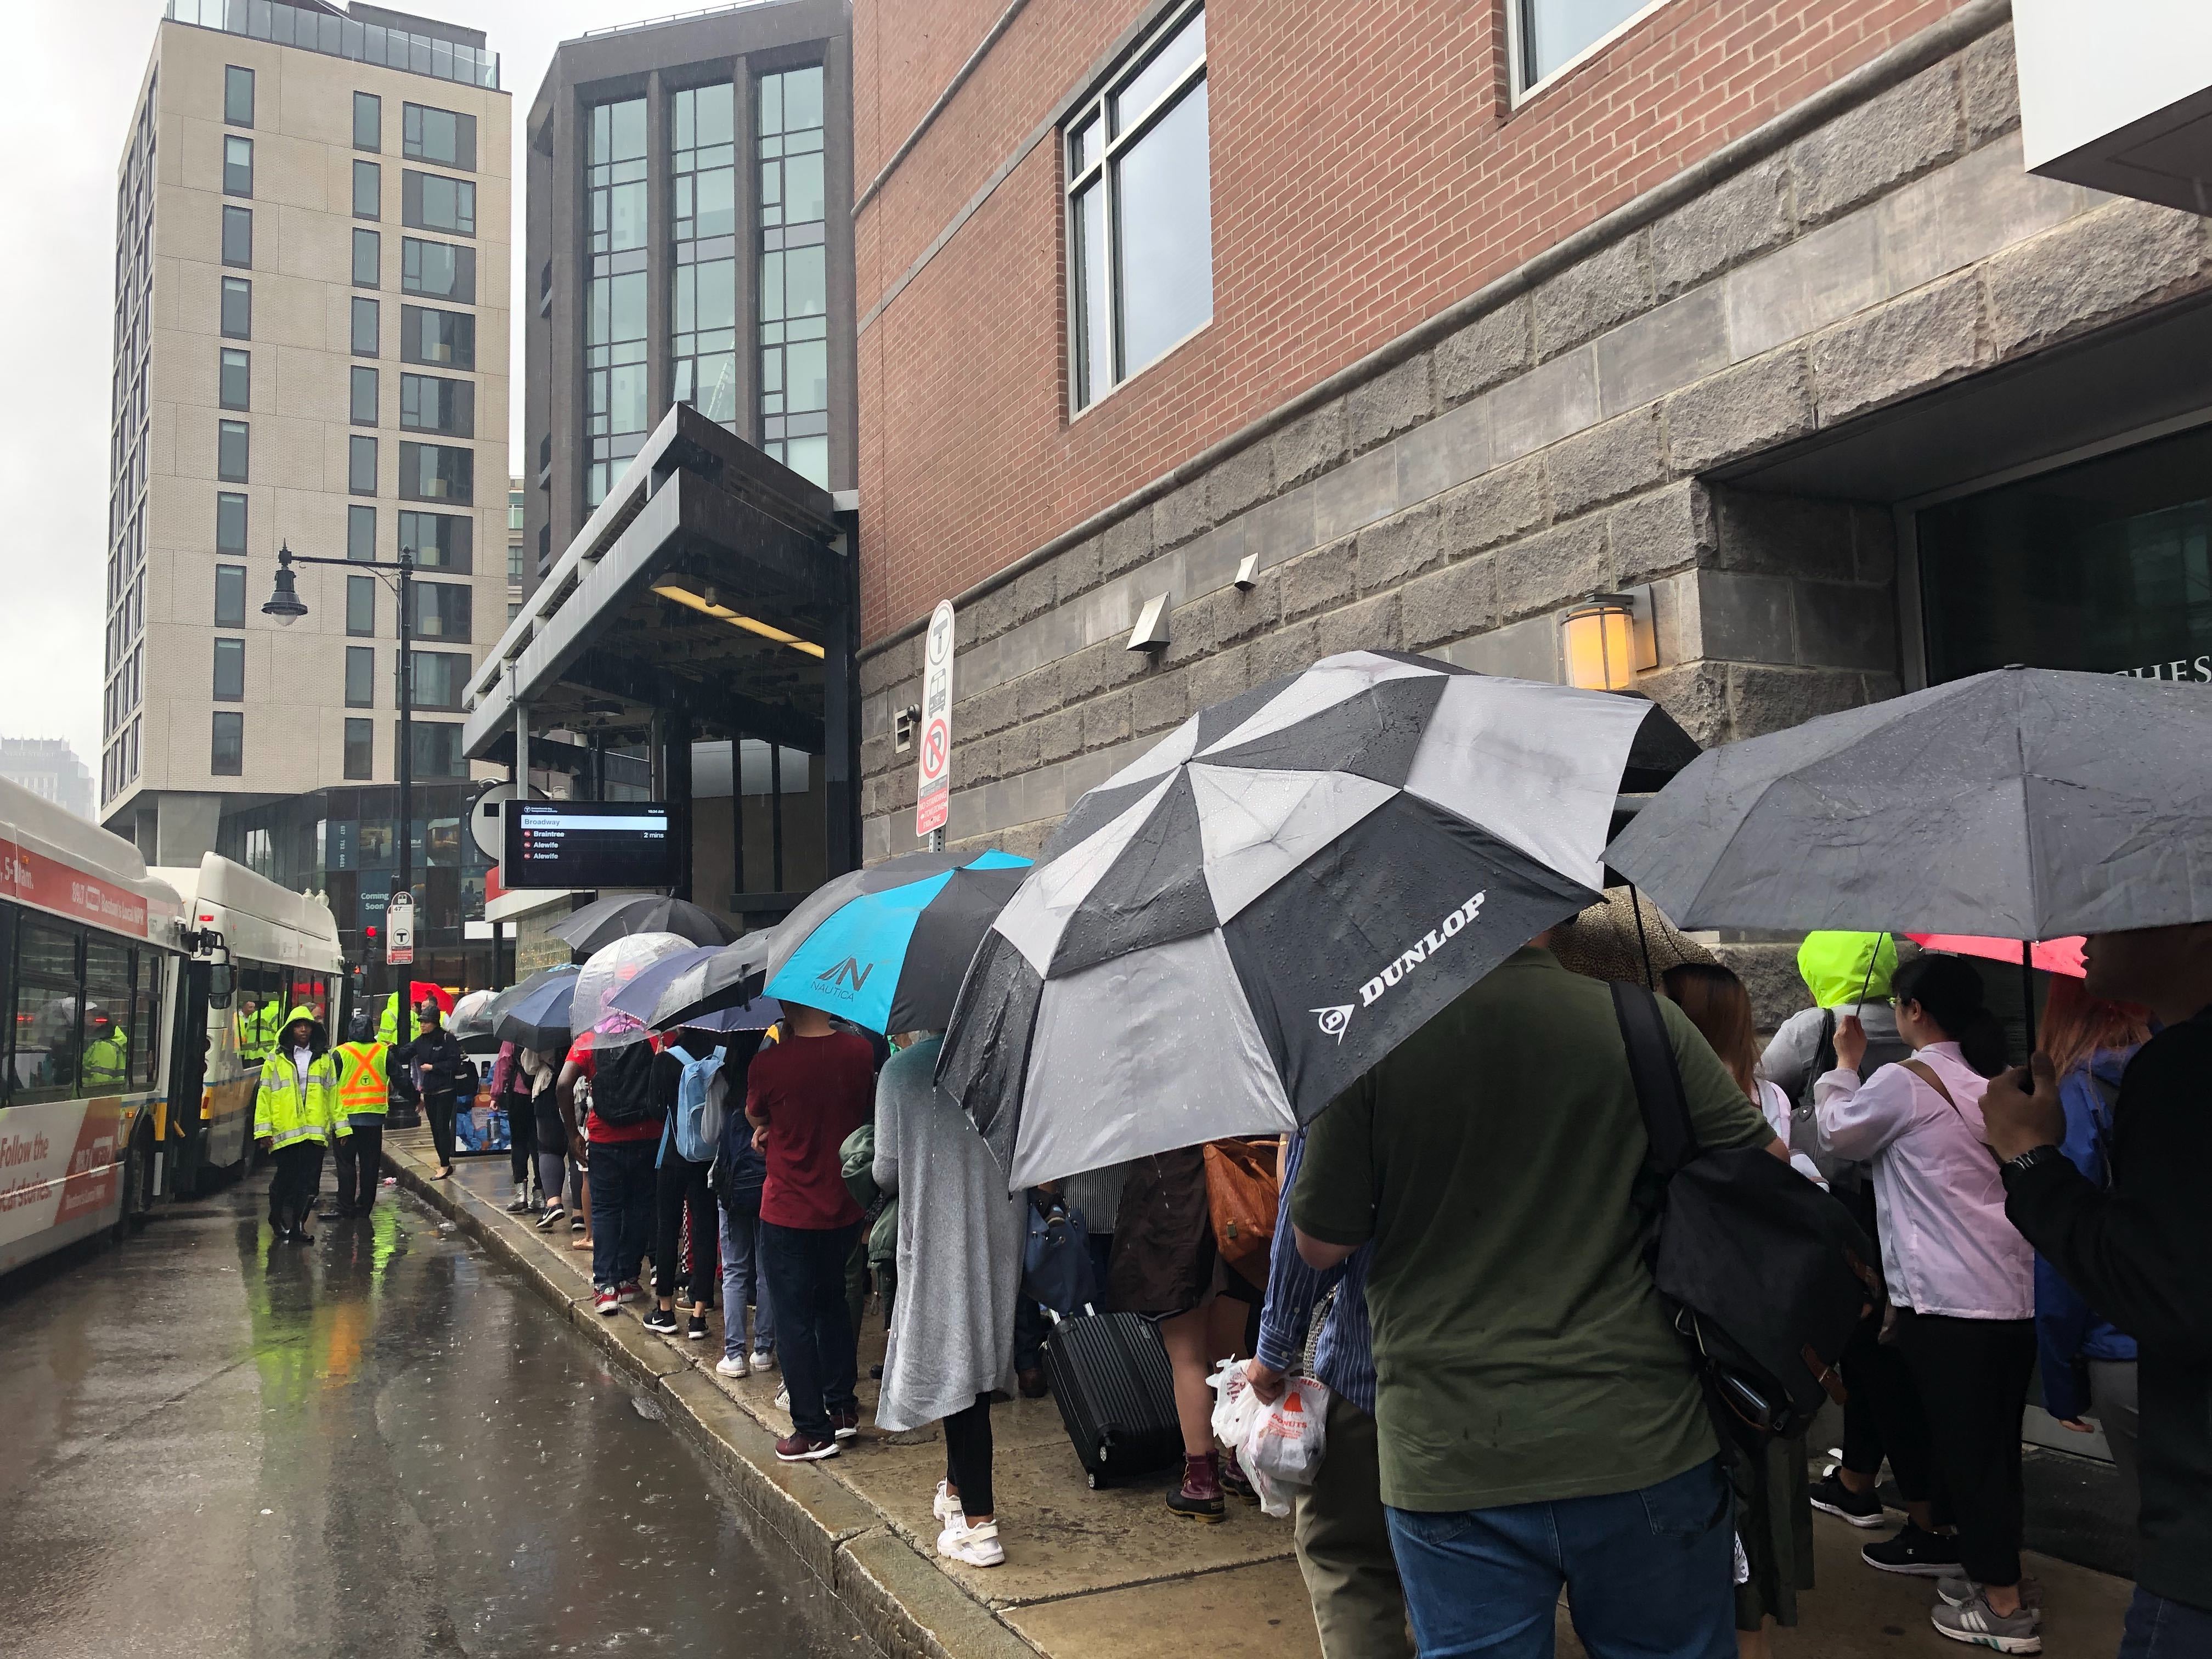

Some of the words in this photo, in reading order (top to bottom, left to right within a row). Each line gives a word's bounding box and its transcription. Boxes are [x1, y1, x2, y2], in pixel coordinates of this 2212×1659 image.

[934, 618, 948, 654] T
[926, 791, 947, 807] STANDING
[360, 893, 390, 901] Coming
[397, 933, 407, 943] T
[1359, 891, 1486, 1008] DUNLOP
[810, 980, 855, 1002] NAUTICA
[0, 1134, 32, 1169] Follow
[33, 1130, 49, 1161] the
[1271, 1413, 1307, 1429] DONUTS
